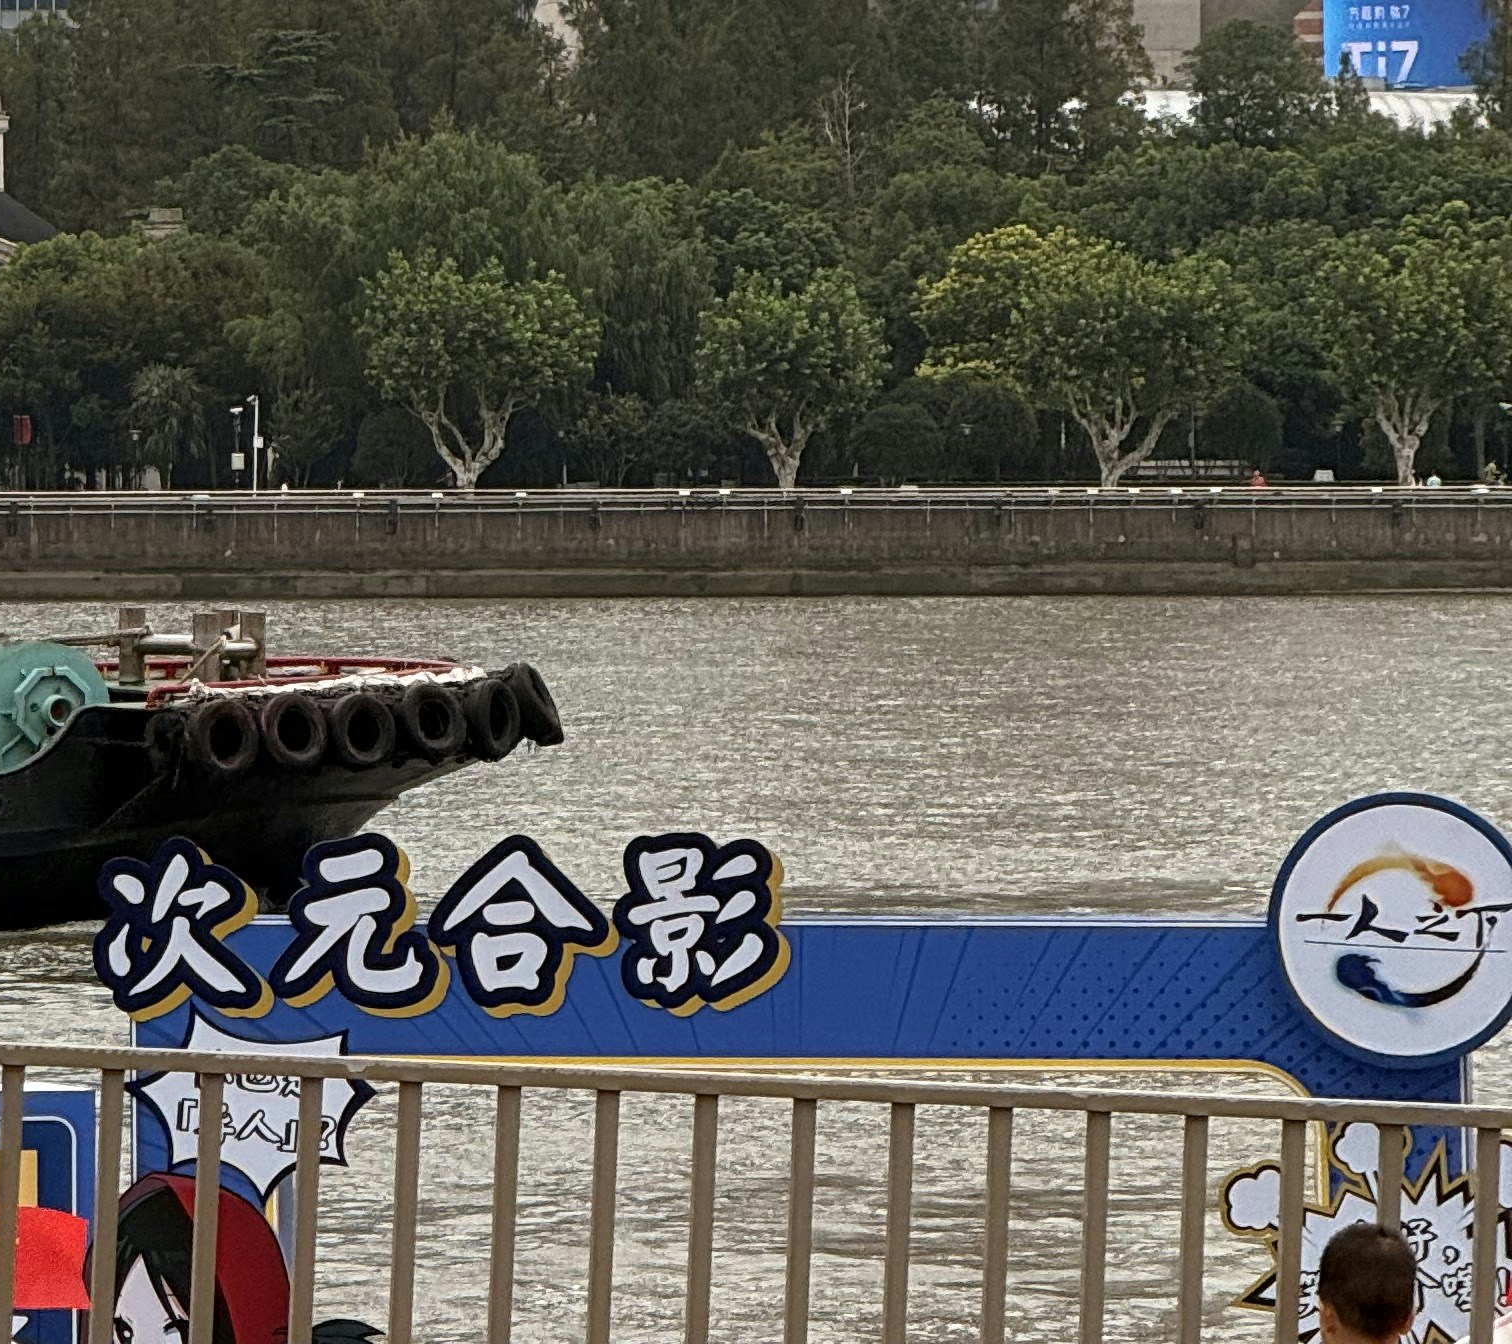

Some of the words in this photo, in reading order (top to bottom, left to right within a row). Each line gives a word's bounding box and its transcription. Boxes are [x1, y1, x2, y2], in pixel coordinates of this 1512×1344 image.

[1342, 40, 1419, 87] Ti7
[100, 838, 778, 1006] 次元合影
[1296, 894, 1512, 949] 一人之下
